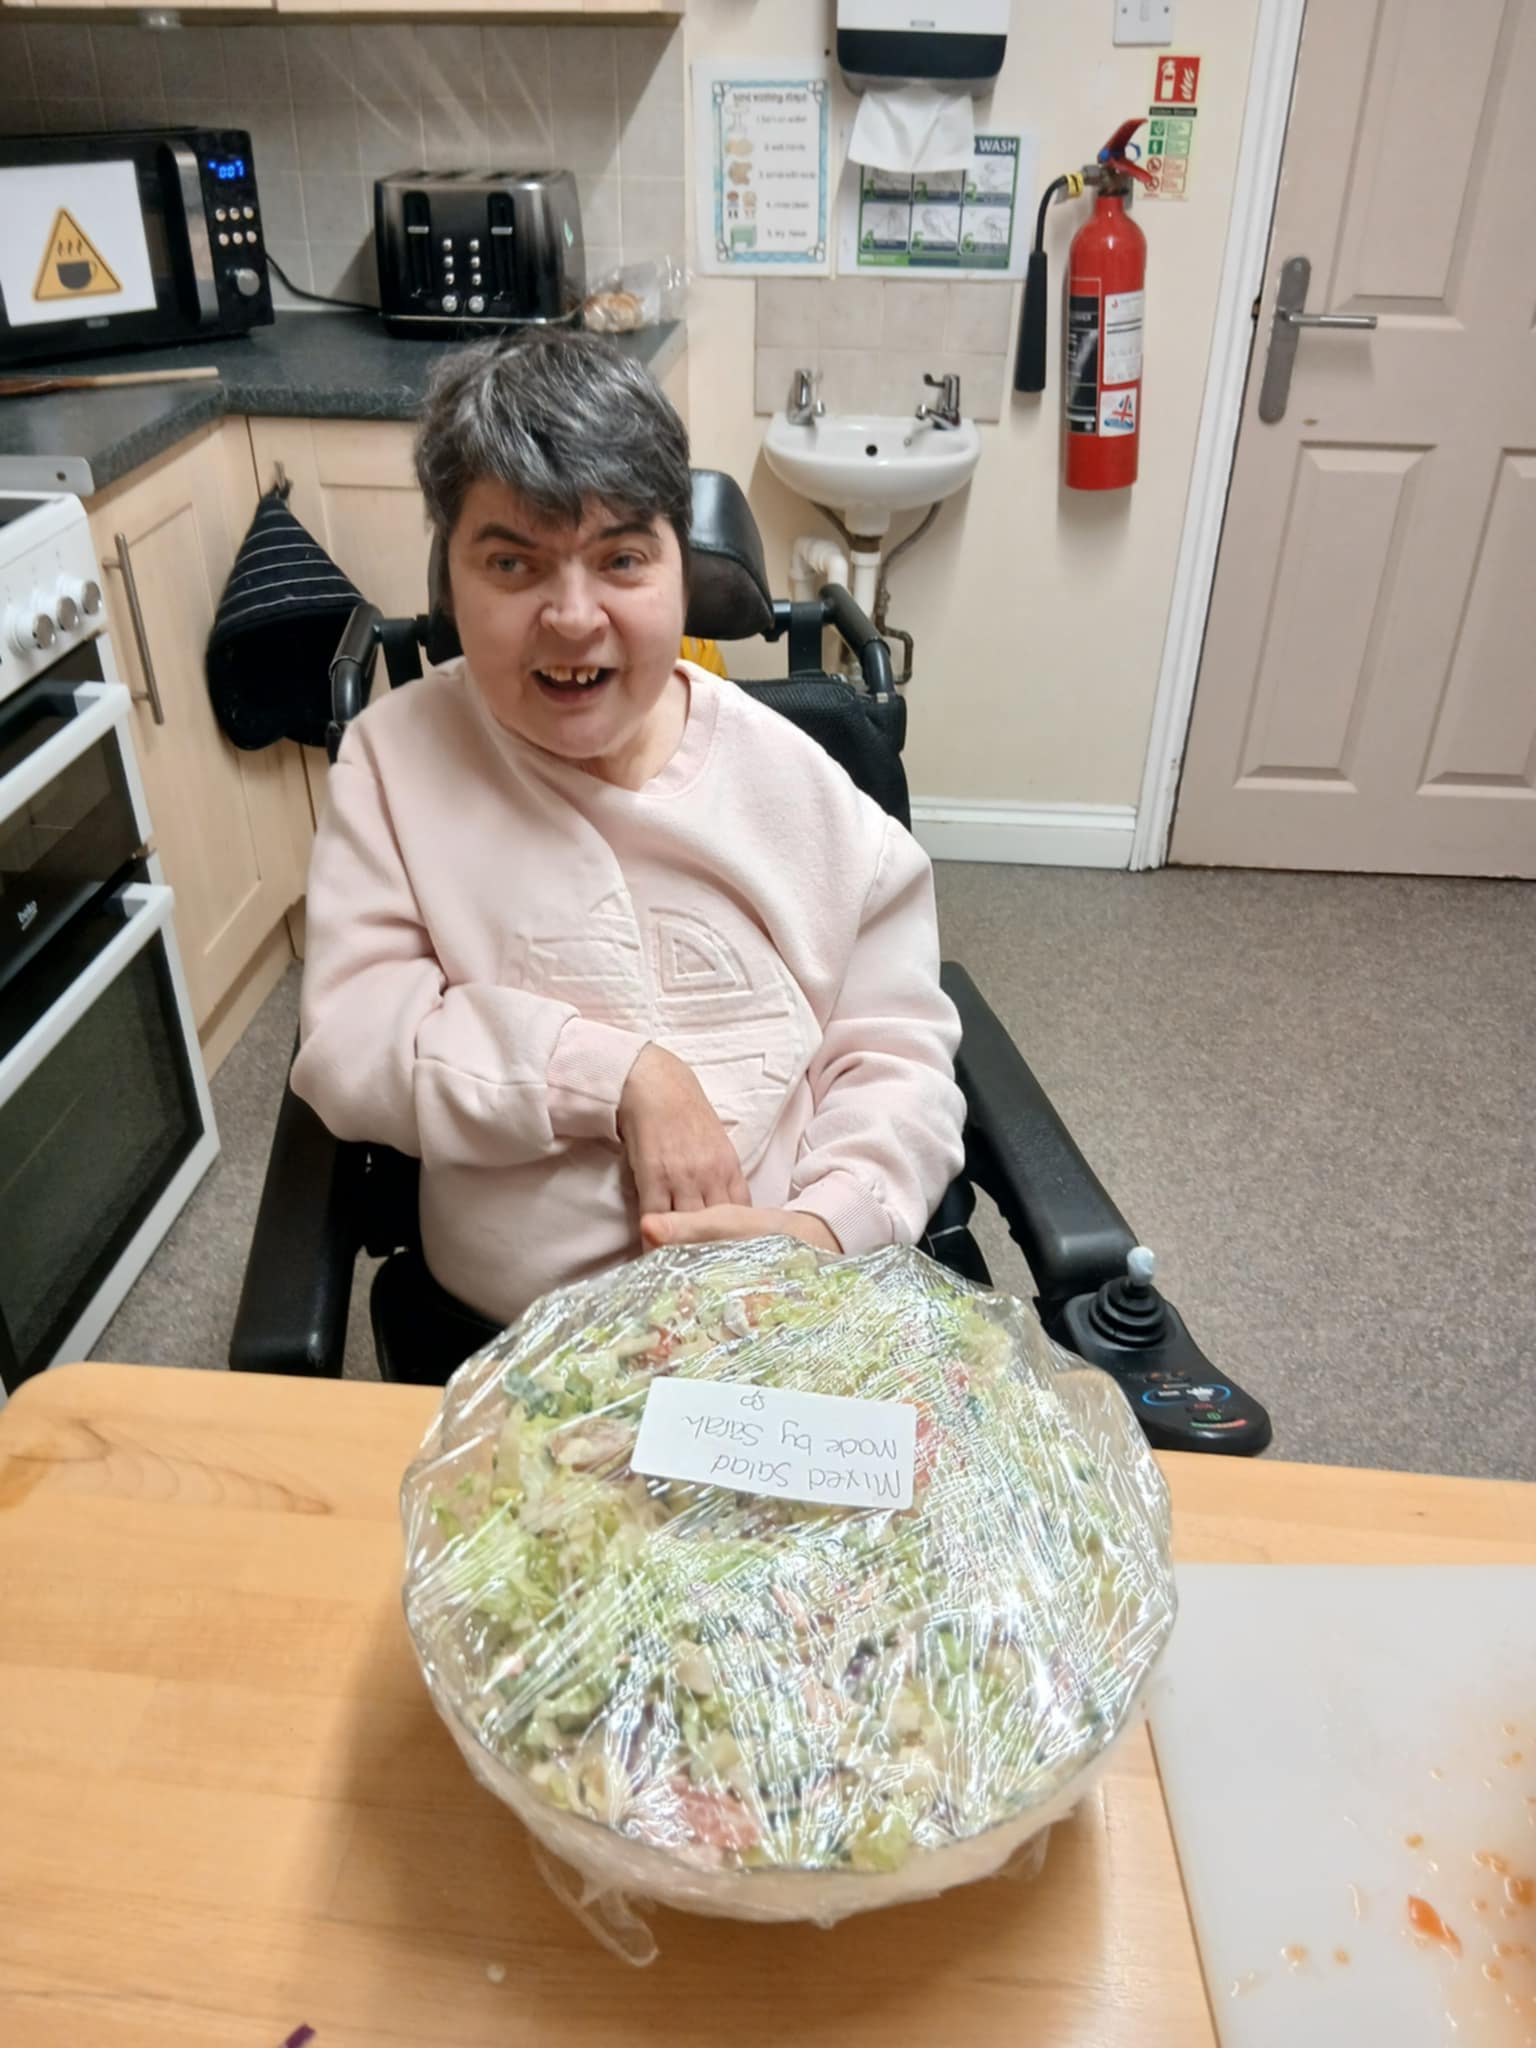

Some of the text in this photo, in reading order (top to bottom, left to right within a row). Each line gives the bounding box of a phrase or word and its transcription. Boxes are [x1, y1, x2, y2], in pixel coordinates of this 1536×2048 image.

[978, 139, 1017, 153] WASH
[685, 1415, 897, 1460] Made by Sarah
[711, 1453, 899, 1498] Mixed Salad
